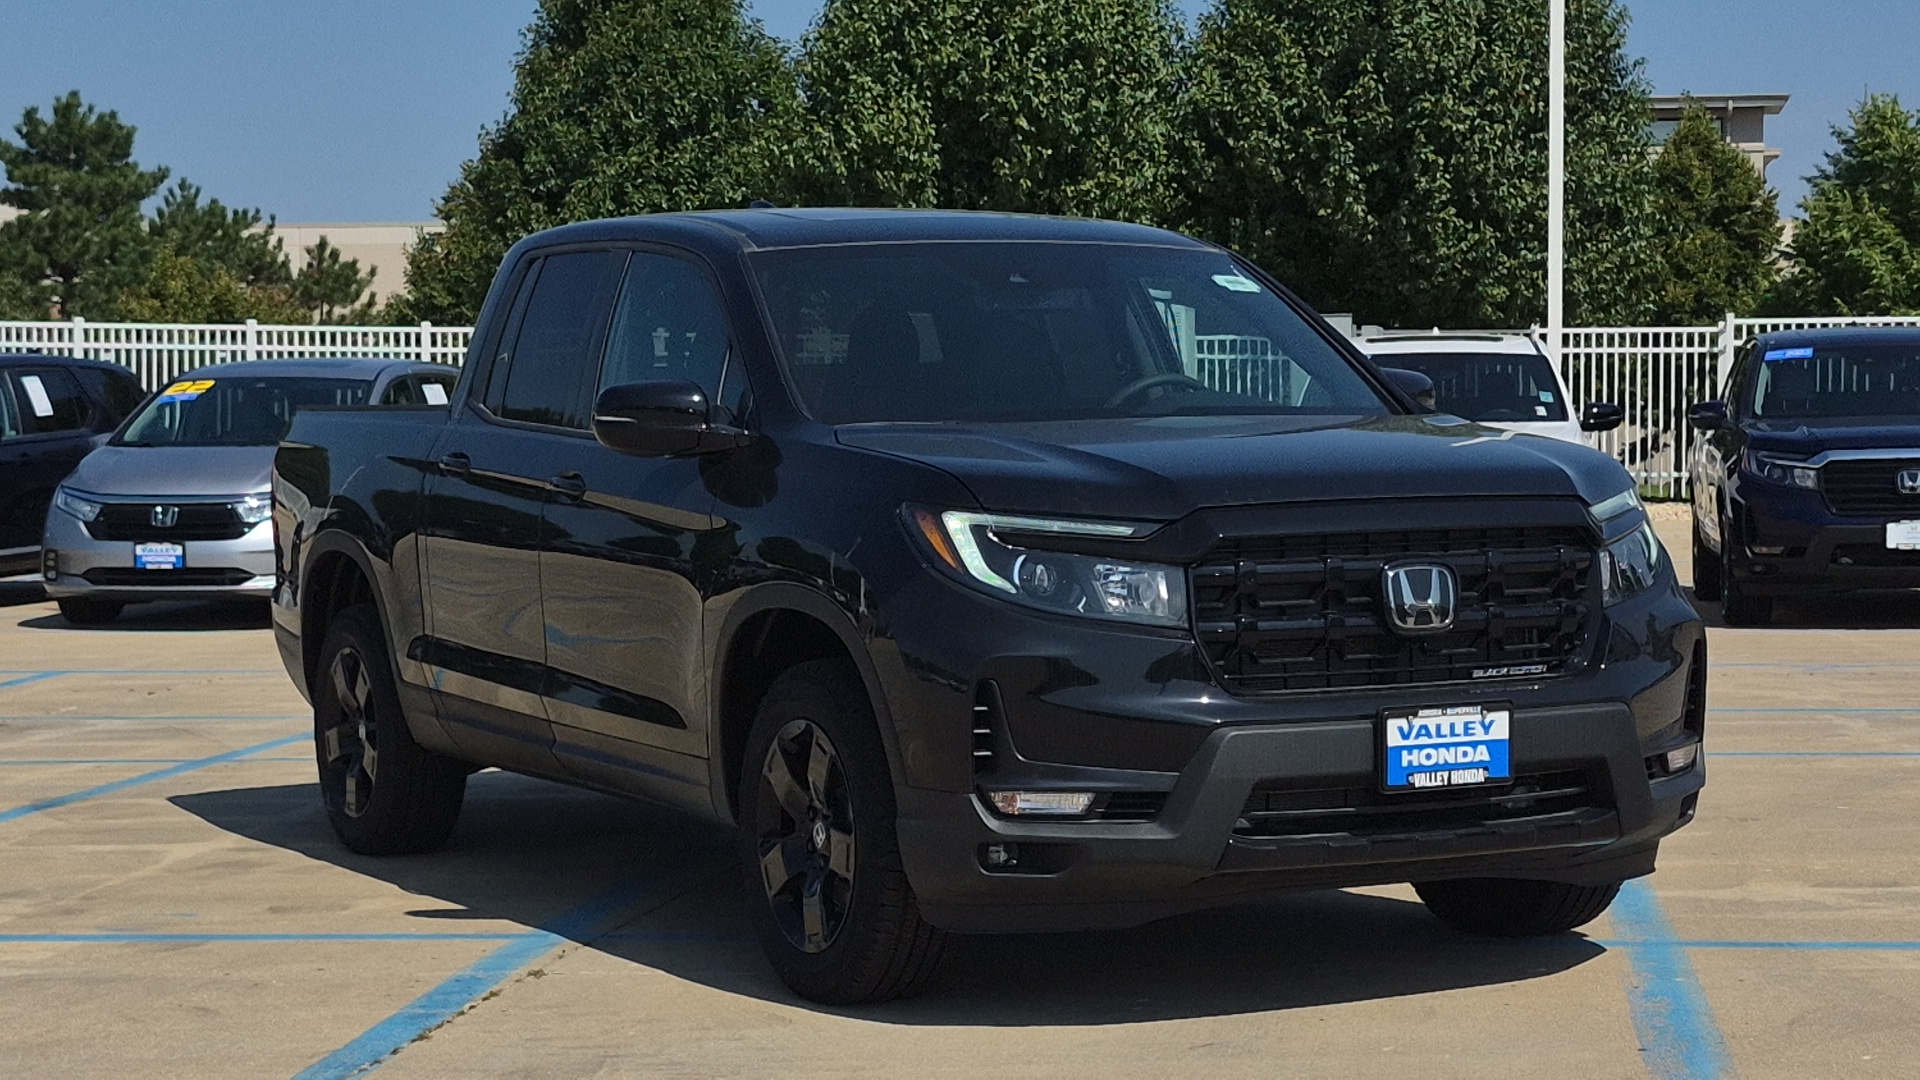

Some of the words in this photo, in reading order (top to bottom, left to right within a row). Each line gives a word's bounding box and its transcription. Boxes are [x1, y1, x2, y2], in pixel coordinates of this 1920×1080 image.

[1397, 719, 1496, 741] VALLEY
[1401, 744, 1491, 767] HONDA
[1413, 770, 1450, 788] VALLEY
[1450, 768, 1485, 784] HONDA
